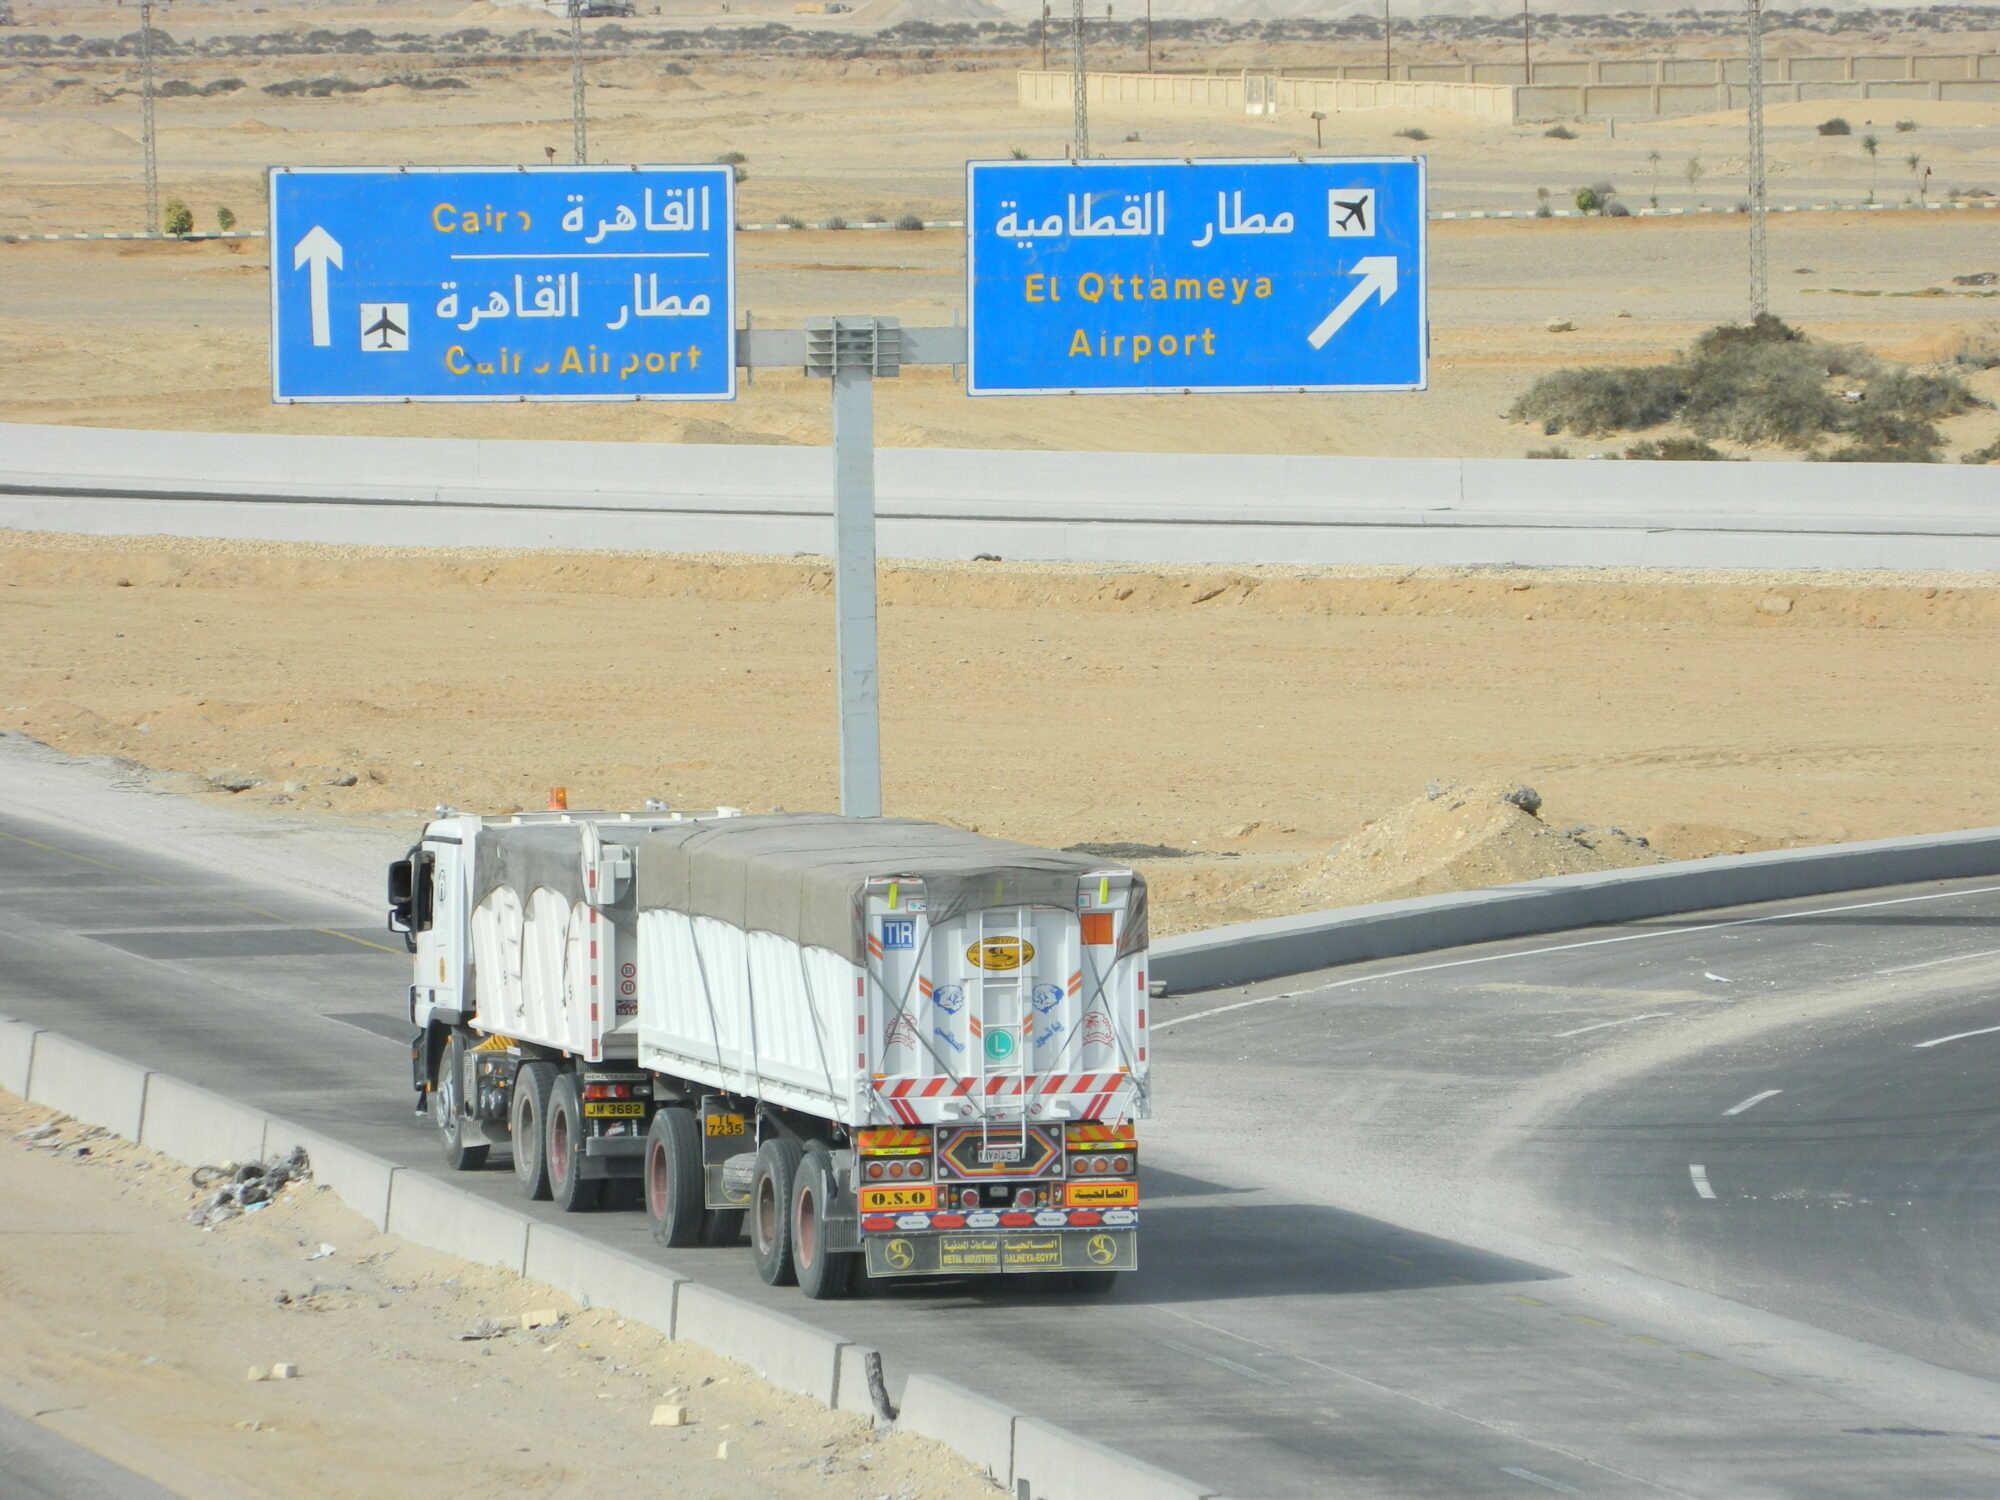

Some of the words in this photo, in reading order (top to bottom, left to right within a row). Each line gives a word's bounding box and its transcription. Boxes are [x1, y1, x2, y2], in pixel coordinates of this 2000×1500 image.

[561, 185, 710, 245] القاهرة
[995, 190, 1166, 249] القطامية
[1191, 190, 1295, 248] مطار
[435, 271, 580, 332] القاهرة
[606, 272, 711, 331] مطار
[1026, 274, 1060, 302] El
[1078, 272, 1273, 305] Qttameya
[1068, 328, 1216, 363] Airport
[884, 921, 913, 945] TIR
[994, 1034, 1007, 1053] L
[588, 1104, 604, 1115] JM
[608, 1104, 642, 1115] 3682
[709, 1124, 743, 1135] 7235
[871, 1191, 926, 1206] O.S.O
[1074, 1188, 1128, 1202] الصالحية
